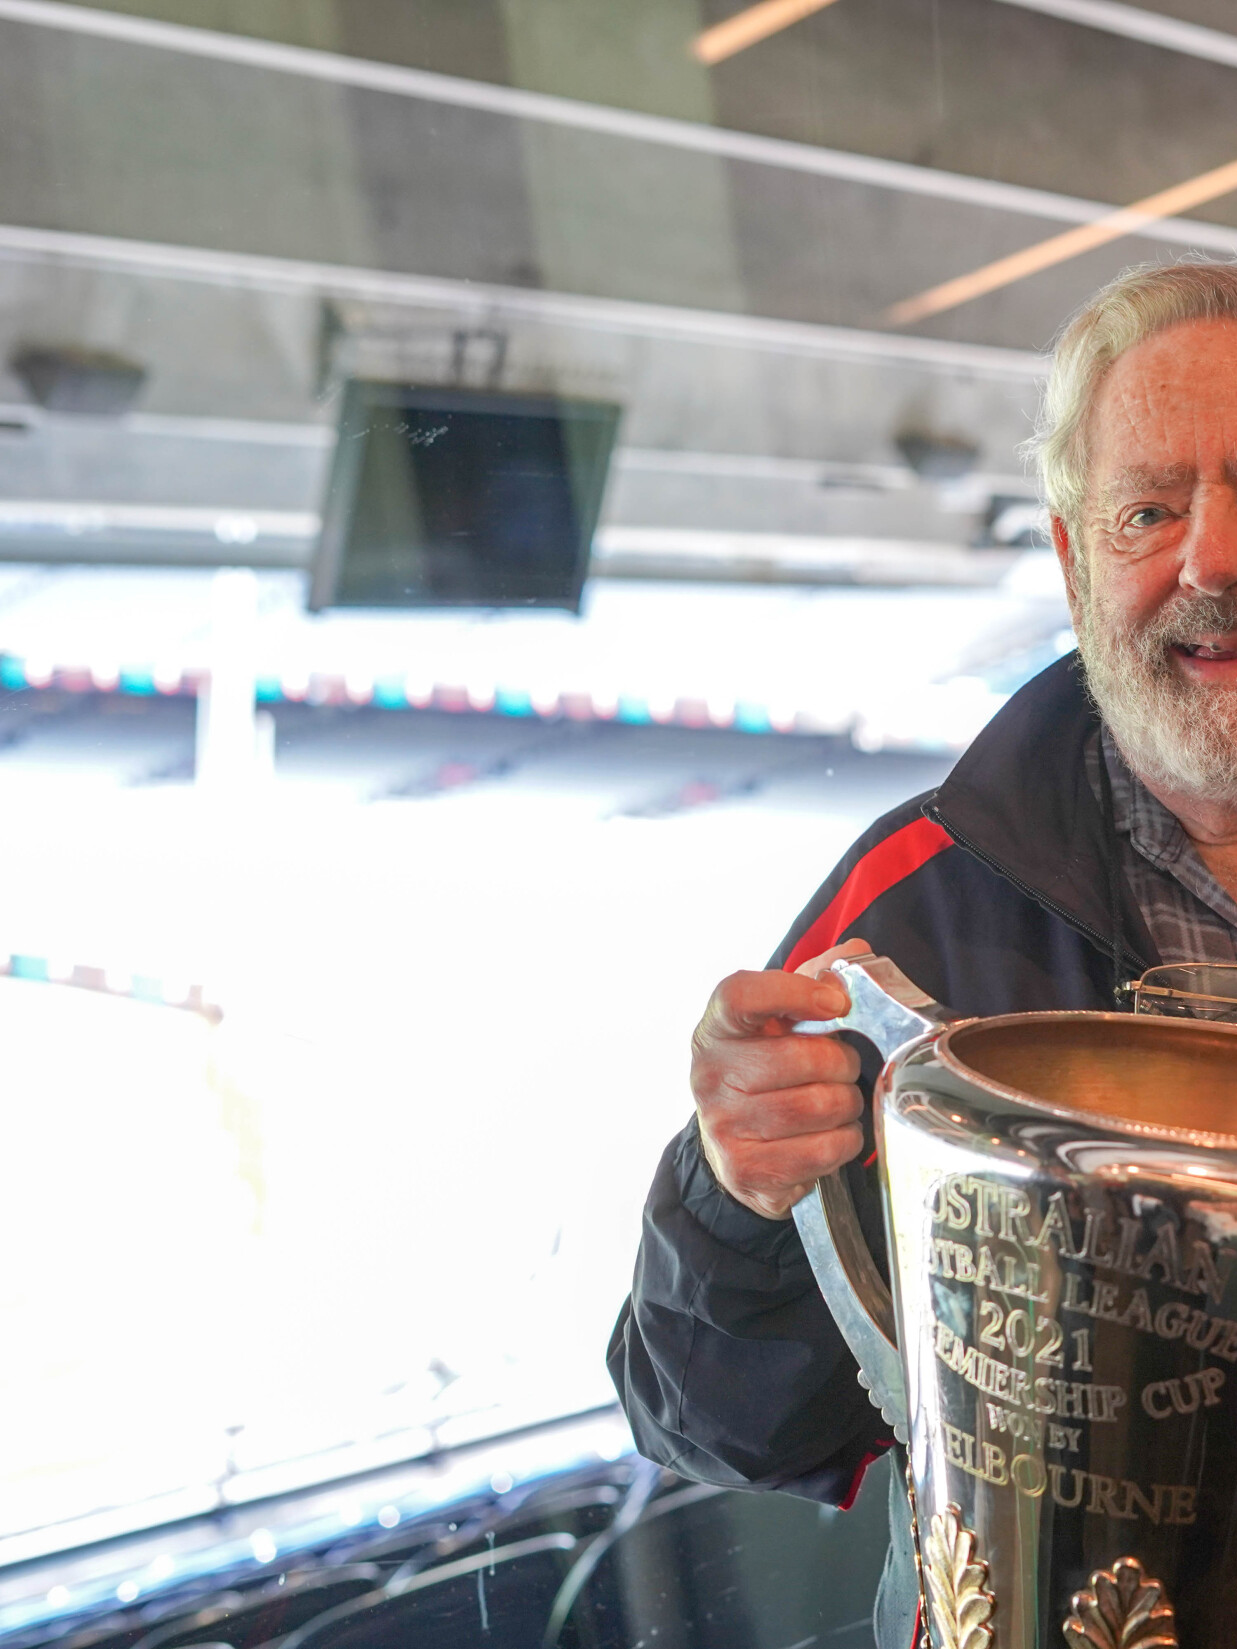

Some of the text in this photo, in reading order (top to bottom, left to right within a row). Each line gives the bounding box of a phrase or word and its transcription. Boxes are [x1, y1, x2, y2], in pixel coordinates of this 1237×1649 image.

[923, 1173, 1237, 1305] USTRALIAN
[928, 1238, 1049, 1303] TBALL
[935, 1321, 1227, 1423] EMIERSHIP CUP
[979, 1300, 1093, 1373] 2021
[986, 1402, 1083, 1453] WON BY
[943, 1421, 1197, 1525] ELBOURNE
